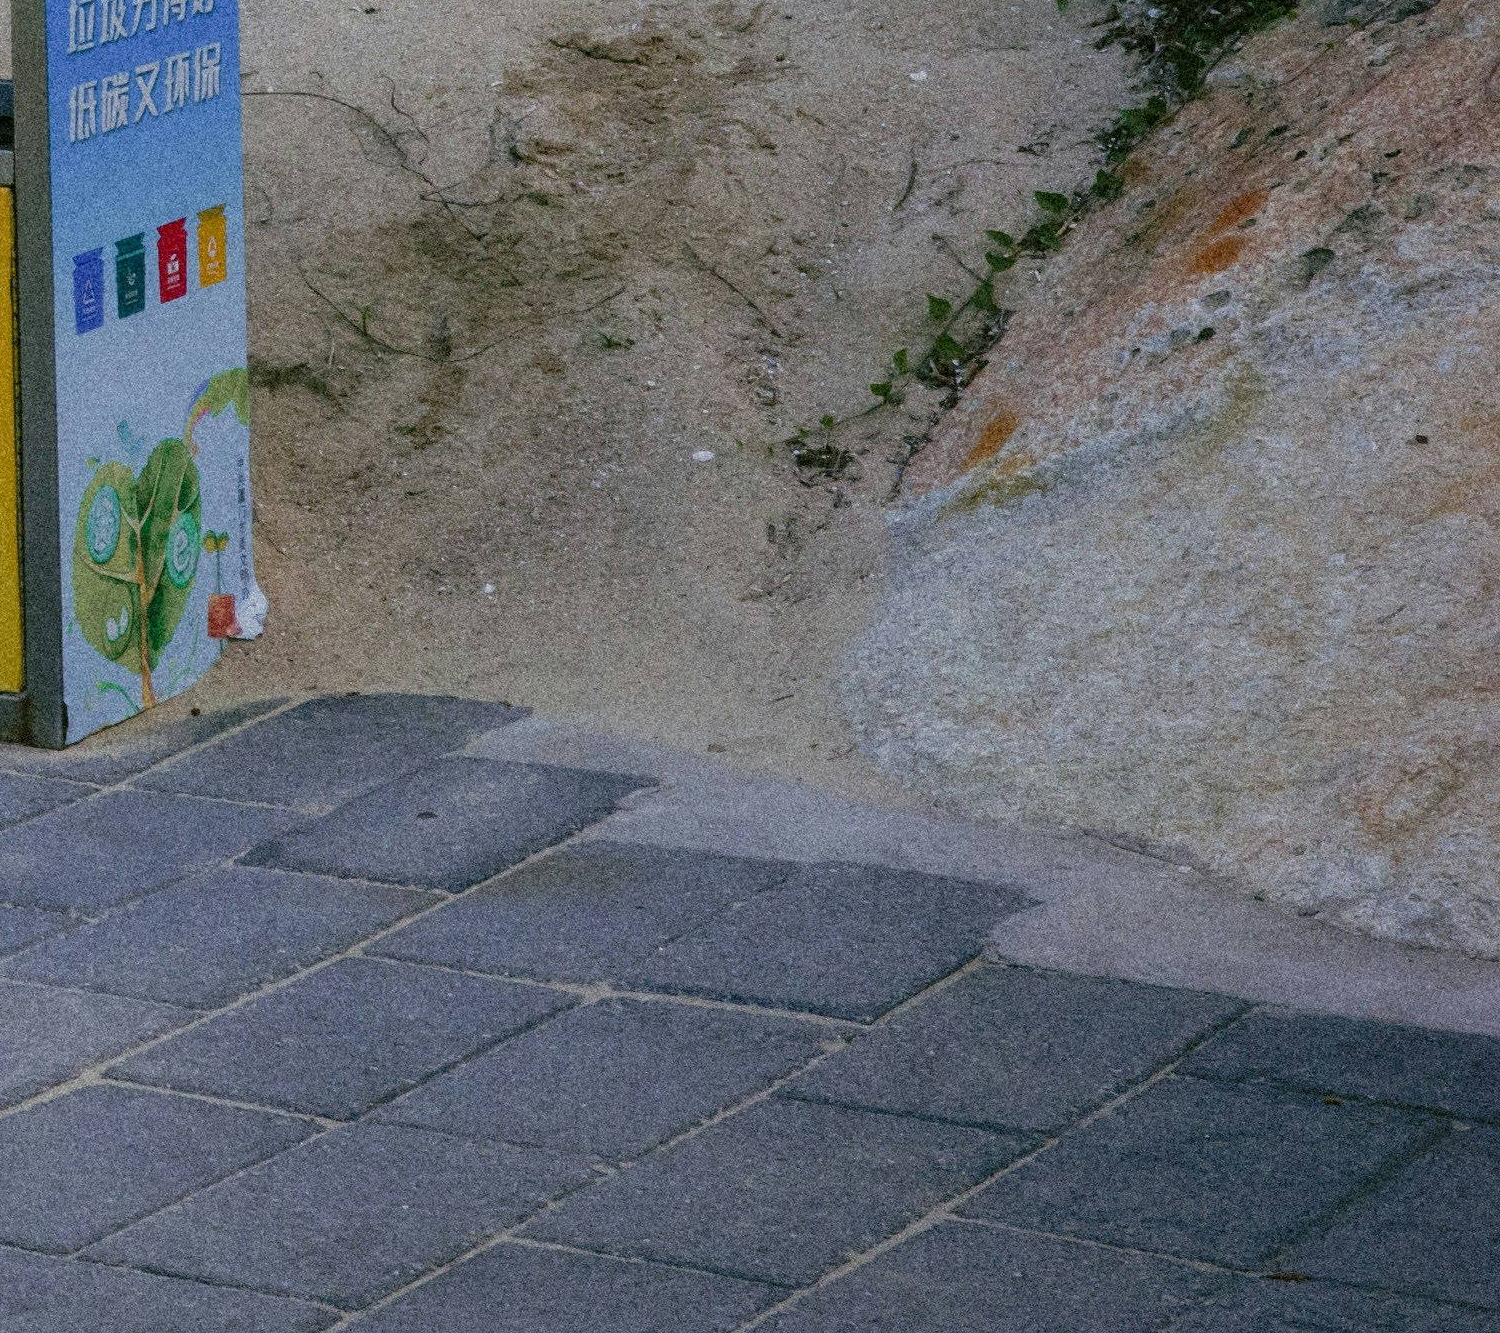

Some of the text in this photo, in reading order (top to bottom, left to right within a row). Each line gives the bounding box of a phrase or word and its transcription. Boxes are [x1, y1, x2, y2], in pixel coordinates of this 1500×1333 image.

[69, 41, 221, 144] 低碳又环保
